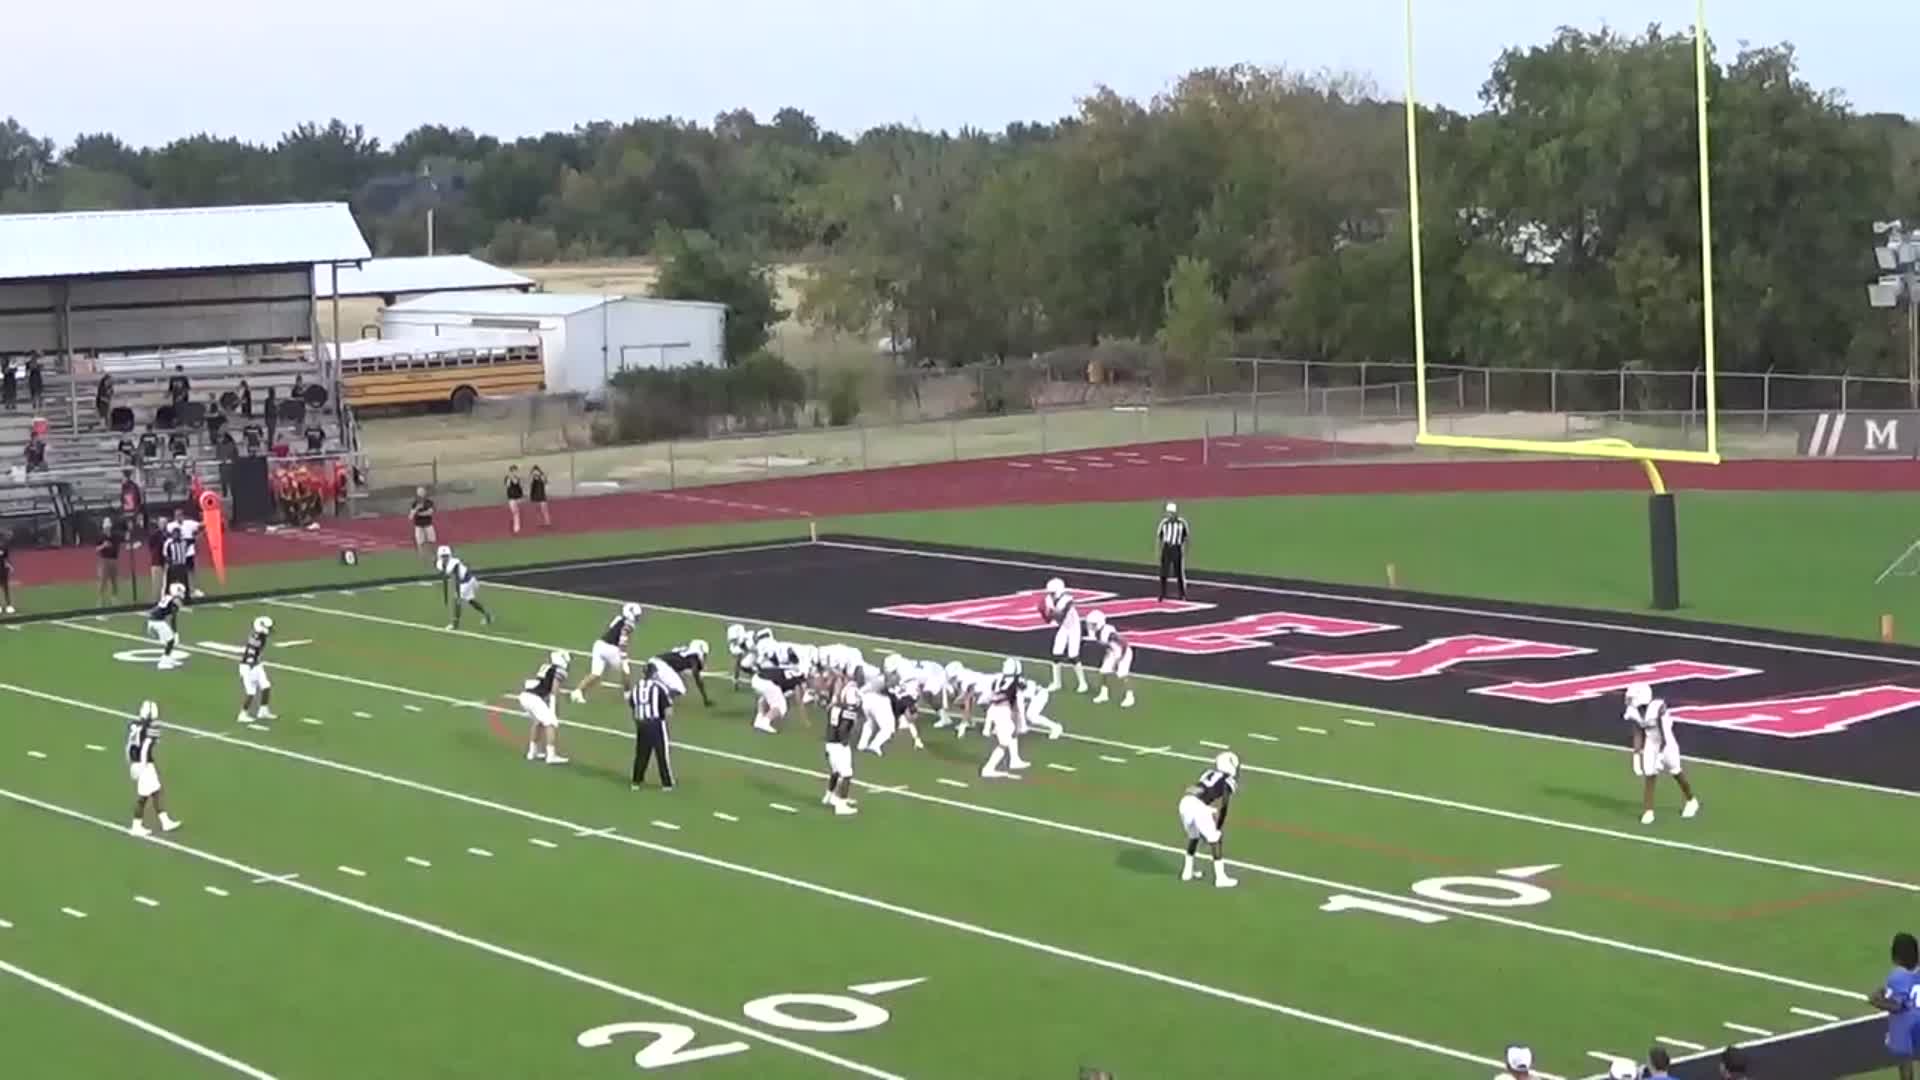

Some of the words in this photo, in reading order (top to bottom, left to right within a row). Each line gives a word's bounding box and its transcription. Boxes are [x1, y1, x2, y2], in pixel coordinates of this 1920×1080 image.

[1864, 419, 1898, 449] M
[866, 587, 1920, 738] MEXIA
[1319, 875, 1551, 923] 10
[577, 993, 890, 1068] 20
